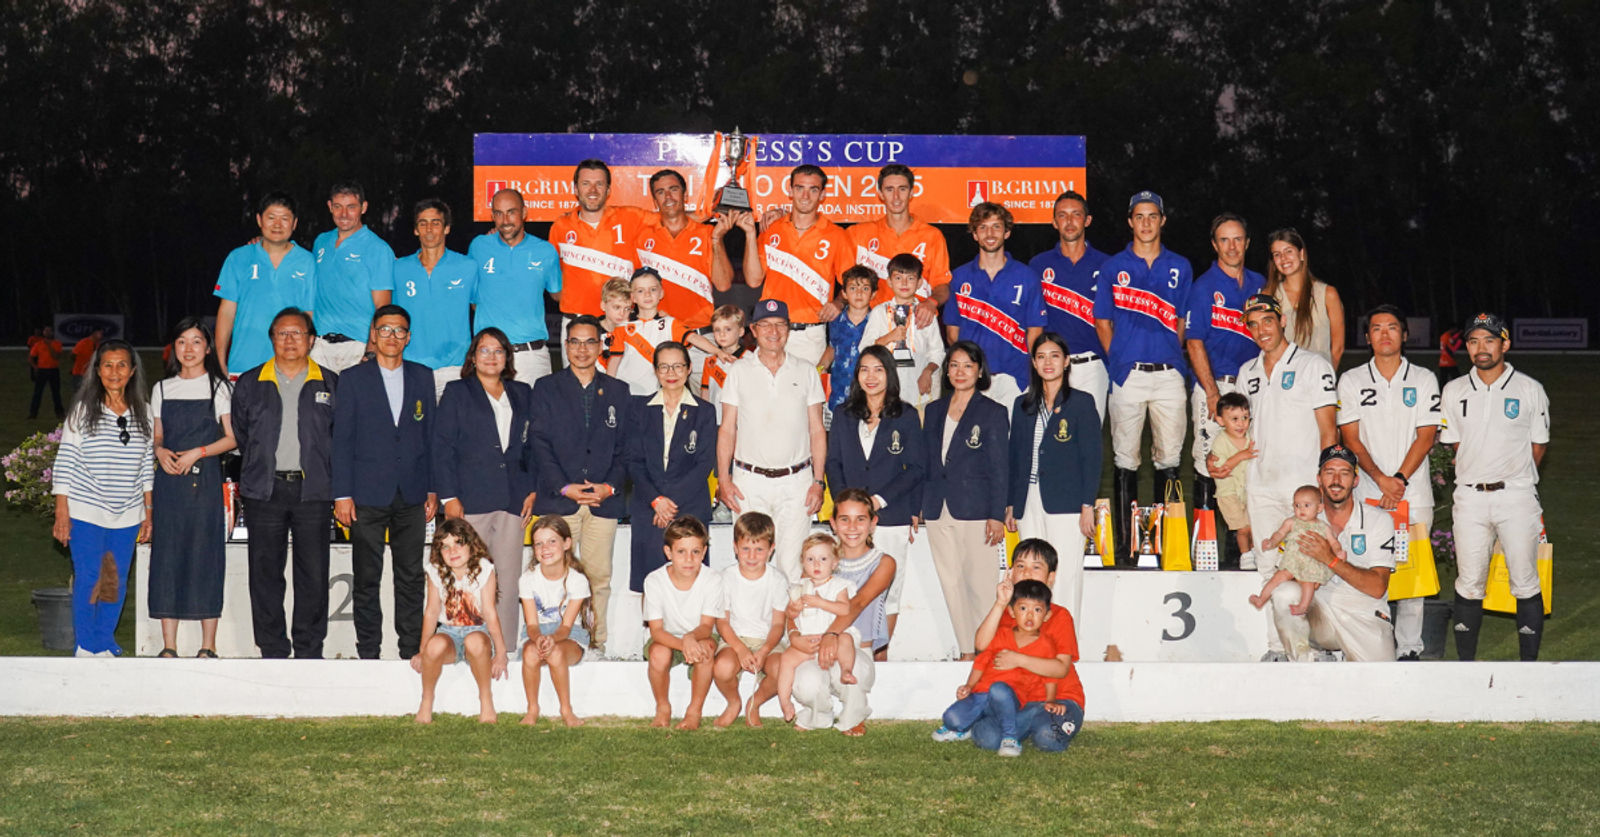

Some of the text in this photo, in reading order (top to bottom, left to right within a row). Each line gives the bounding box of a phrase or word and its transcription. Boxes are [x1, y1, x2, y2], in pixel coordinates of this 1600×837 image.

[656, 139, 904, 163] PRESS'S CUP
[510, 180, 576, 195] B.GRIM
[781, 175, 852, 198] OEN
[860, 175, 925, 198] 25
[992, 179, 1075, 195] B.GRIMM
[525, 200, 555, 209] SINCE
[766, 204, 842, 215] CHITADA
[846, 204, 887, 215] INSTITU
[1003, 200, 1056, 209] SINCE 187
[611, 223, 625, 245] 1
[688, 236, 703, 256] 2
[814, 239, 831, 260] 3
[912, 242, 927, 262] 4
[316, 248, 325, 264] 2
[250, 264, 259, 280] 1
[482, 257, 496, 275] 4
[1167, 268, 1180, 289] 3
[405, 280, 416, 297] 3
[1011, 284, 1023, 306] 1
[1043, 289, 1080, 309] INCESS'S
[1113, 292, 1159, 310] RINCESS'S
[658, 319, 666, 331] 3
[957, 301, 997, 323] RINCESS'S
[998, 320, 1016, 334] CUP
[1247, 377, 1260, 395] 3
[1322, 374, 1336, 391] 3
[1360, 389, 1377, 406] 2
[1430, 395, 1441, 412] 2
[1459, 399, 1468, 417] 1
[1380, 536, 1396, 554] 4
[329, 573, 354, 621] 2
[1162, 592, 1196, 640] 3
